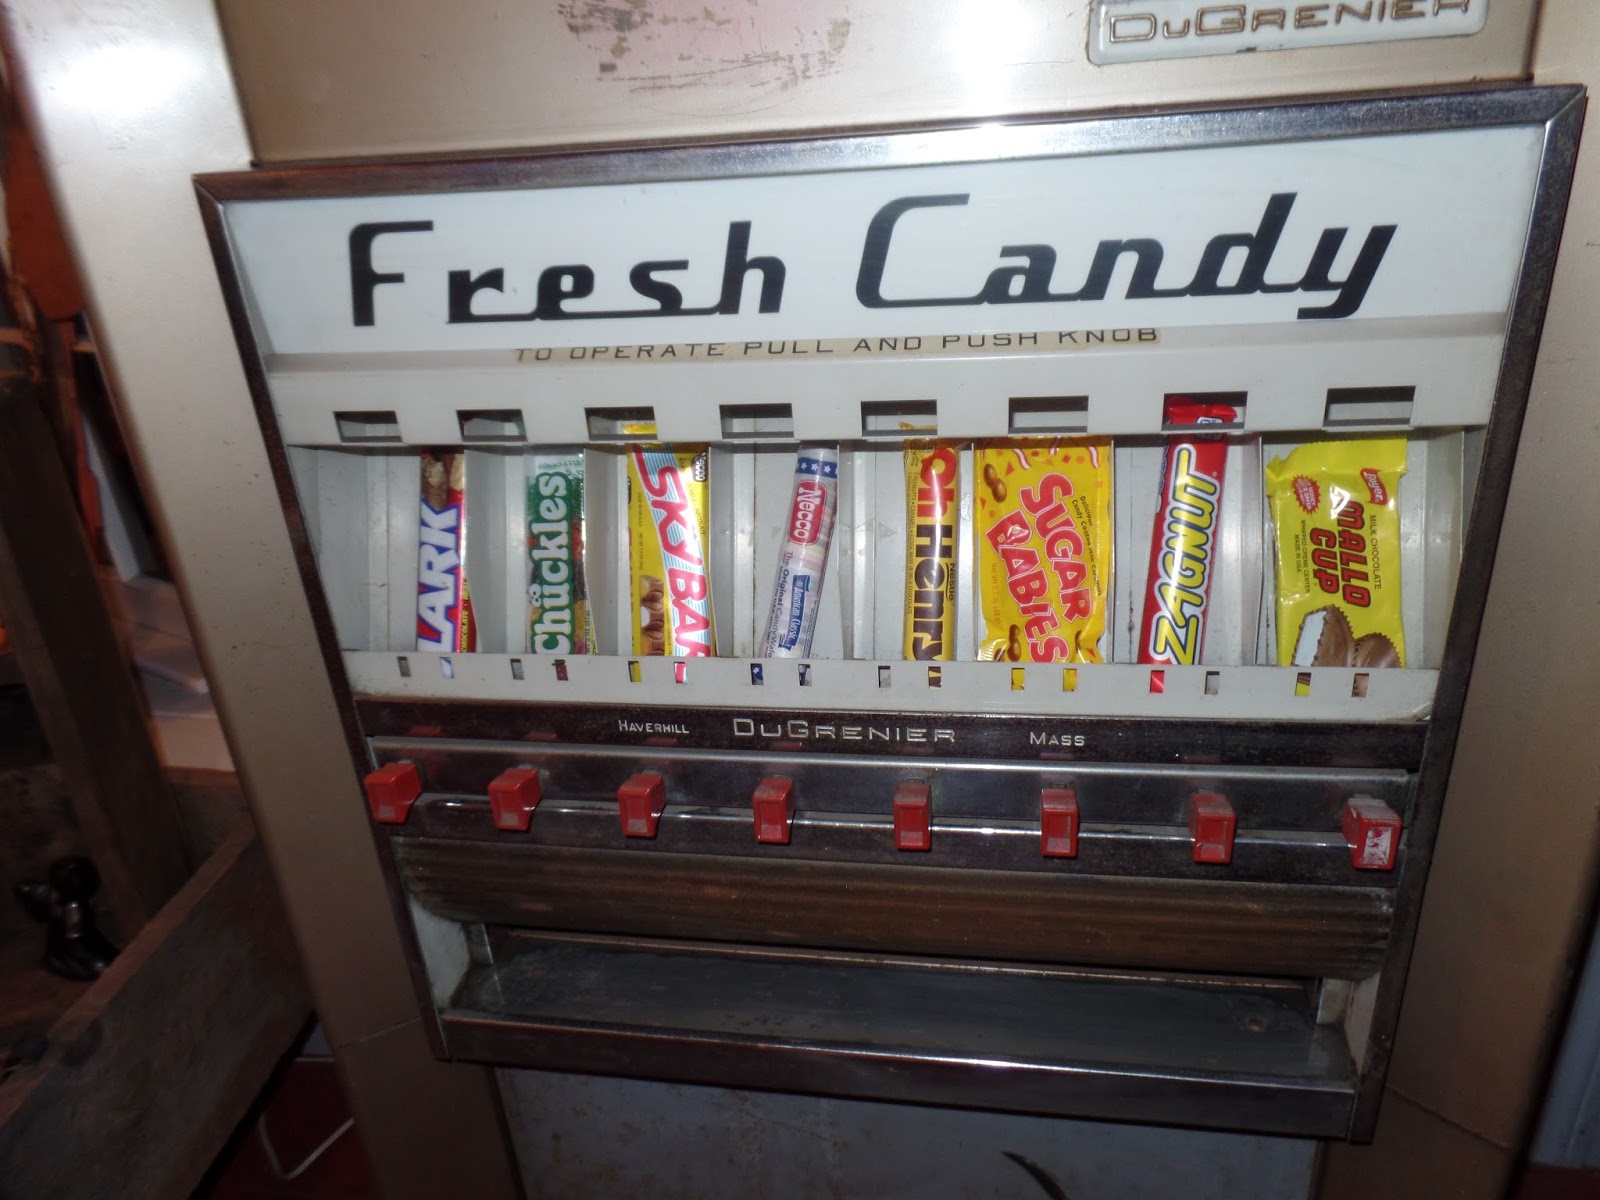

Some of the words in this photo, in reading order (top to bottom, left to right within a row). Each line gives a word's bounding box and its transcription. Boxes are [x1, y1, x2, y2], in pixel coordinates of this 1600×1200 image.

[348, 219, 787, 327] Fresh
[855, 191, 1397, 321] Candy
[515, 347, 552, 363] TO
[569, 342, 726, 361] OPERATE
[742, 339, 835, 357] PULL
[853, 335, 923, 353] AND
[942, 331, 1039, 349] PUSH
[1058, 328, 1159, 345] KNOB
[631, 444, 704, 567] SKY
[916, 447, 957, 518] Oh
[1363, 471, 1383, 501] Boyer
[793, 485, 823, 540] Necco
[1072, 499, 1084, 519] Candy
[1080, 520, 1092, 546] Coated
[1369, 515, 1377, 536] MILK
[1020, 472, 1093, 623] SUGAR
[1152, 446, 1218, 665] ZAGNUT
[1301, 547, 1309, 568] CREME
[1309, 527, 1341, 595] CUP
[1337, 501, 1372, 608] MALLO
[1370, 538, 1382, 590] CHOCOLATE
[777, 568, 790, 606] Original
[985, 508, 1070, 664] BABIES
[1303, 569, 1311, 593] CENTER
[770, 607, 783, 635] Candy
[788, 618, 801, 640] Classic
[1030, 731, 1085, 747] MASS
